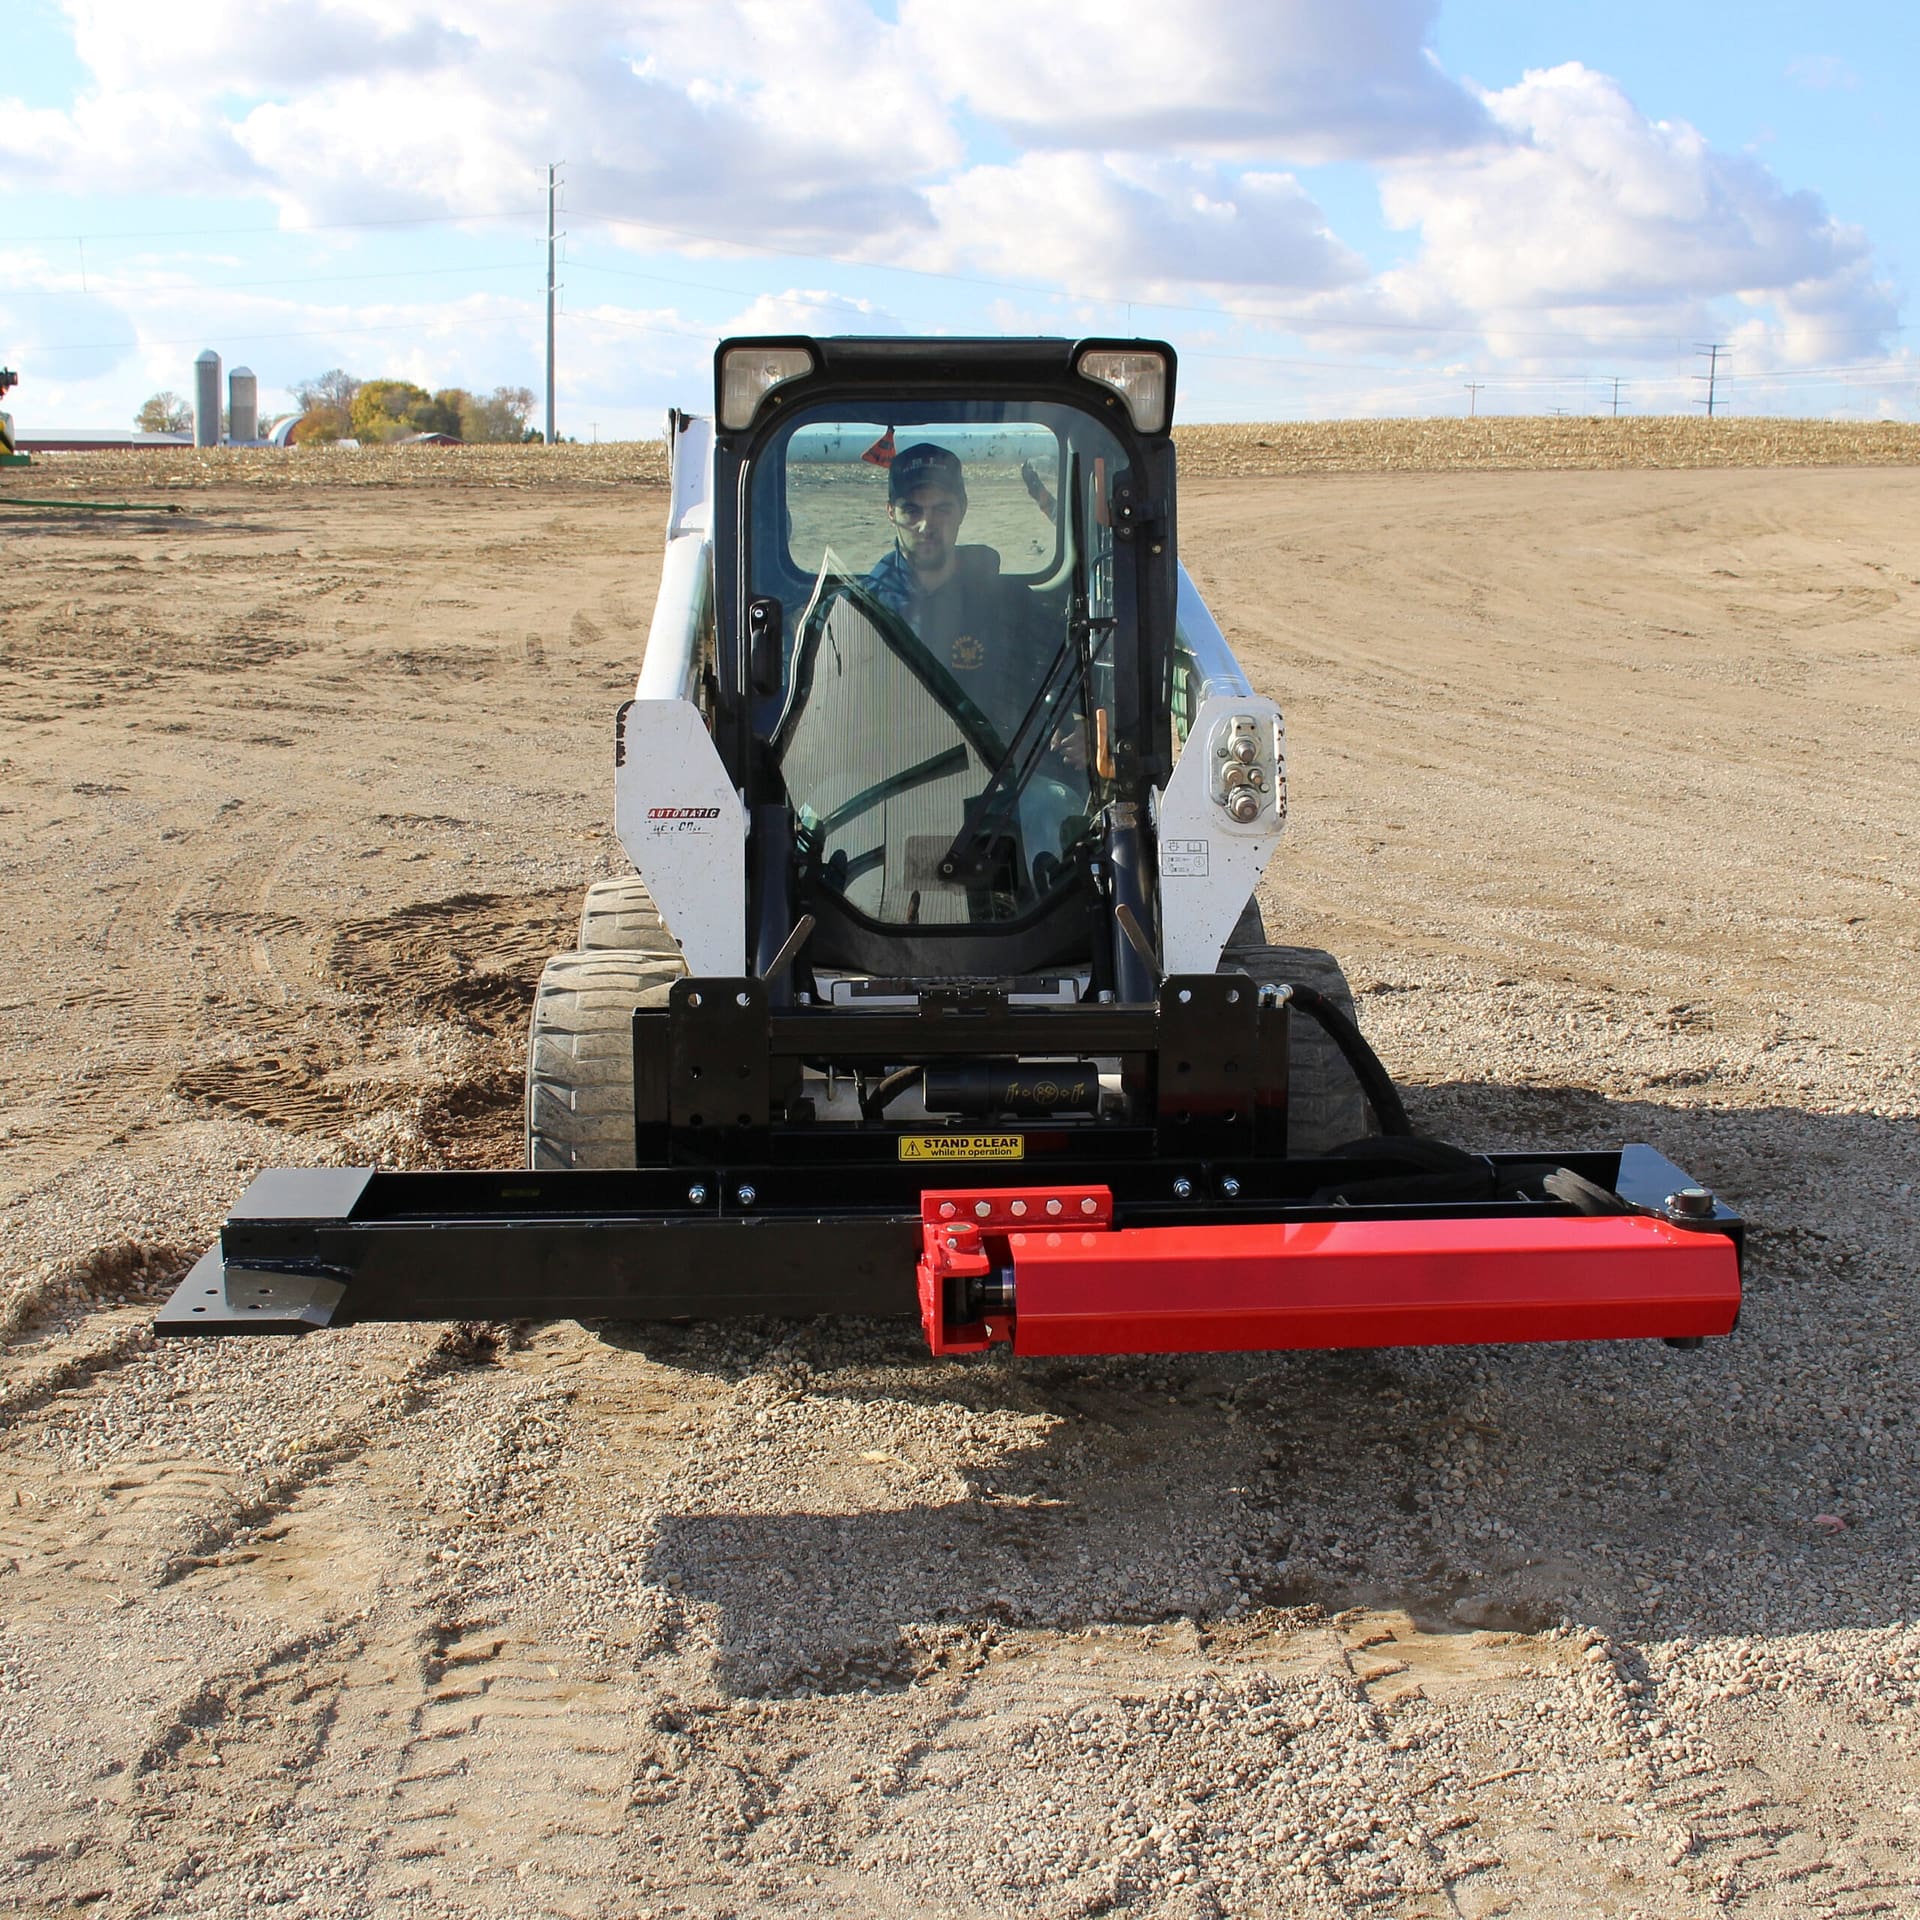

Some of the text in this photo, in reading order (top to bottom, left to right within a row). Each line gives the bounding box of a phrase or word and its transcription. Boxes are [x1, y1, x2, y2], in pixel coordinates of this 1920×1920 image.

[648, 809, 718, 818] AUTOMATIC
[924, 1138, 1018, 1148] STAND CLEAR
[931, 1148, 955, 1156] while
[968, 1147, 1012, 1157] operation
